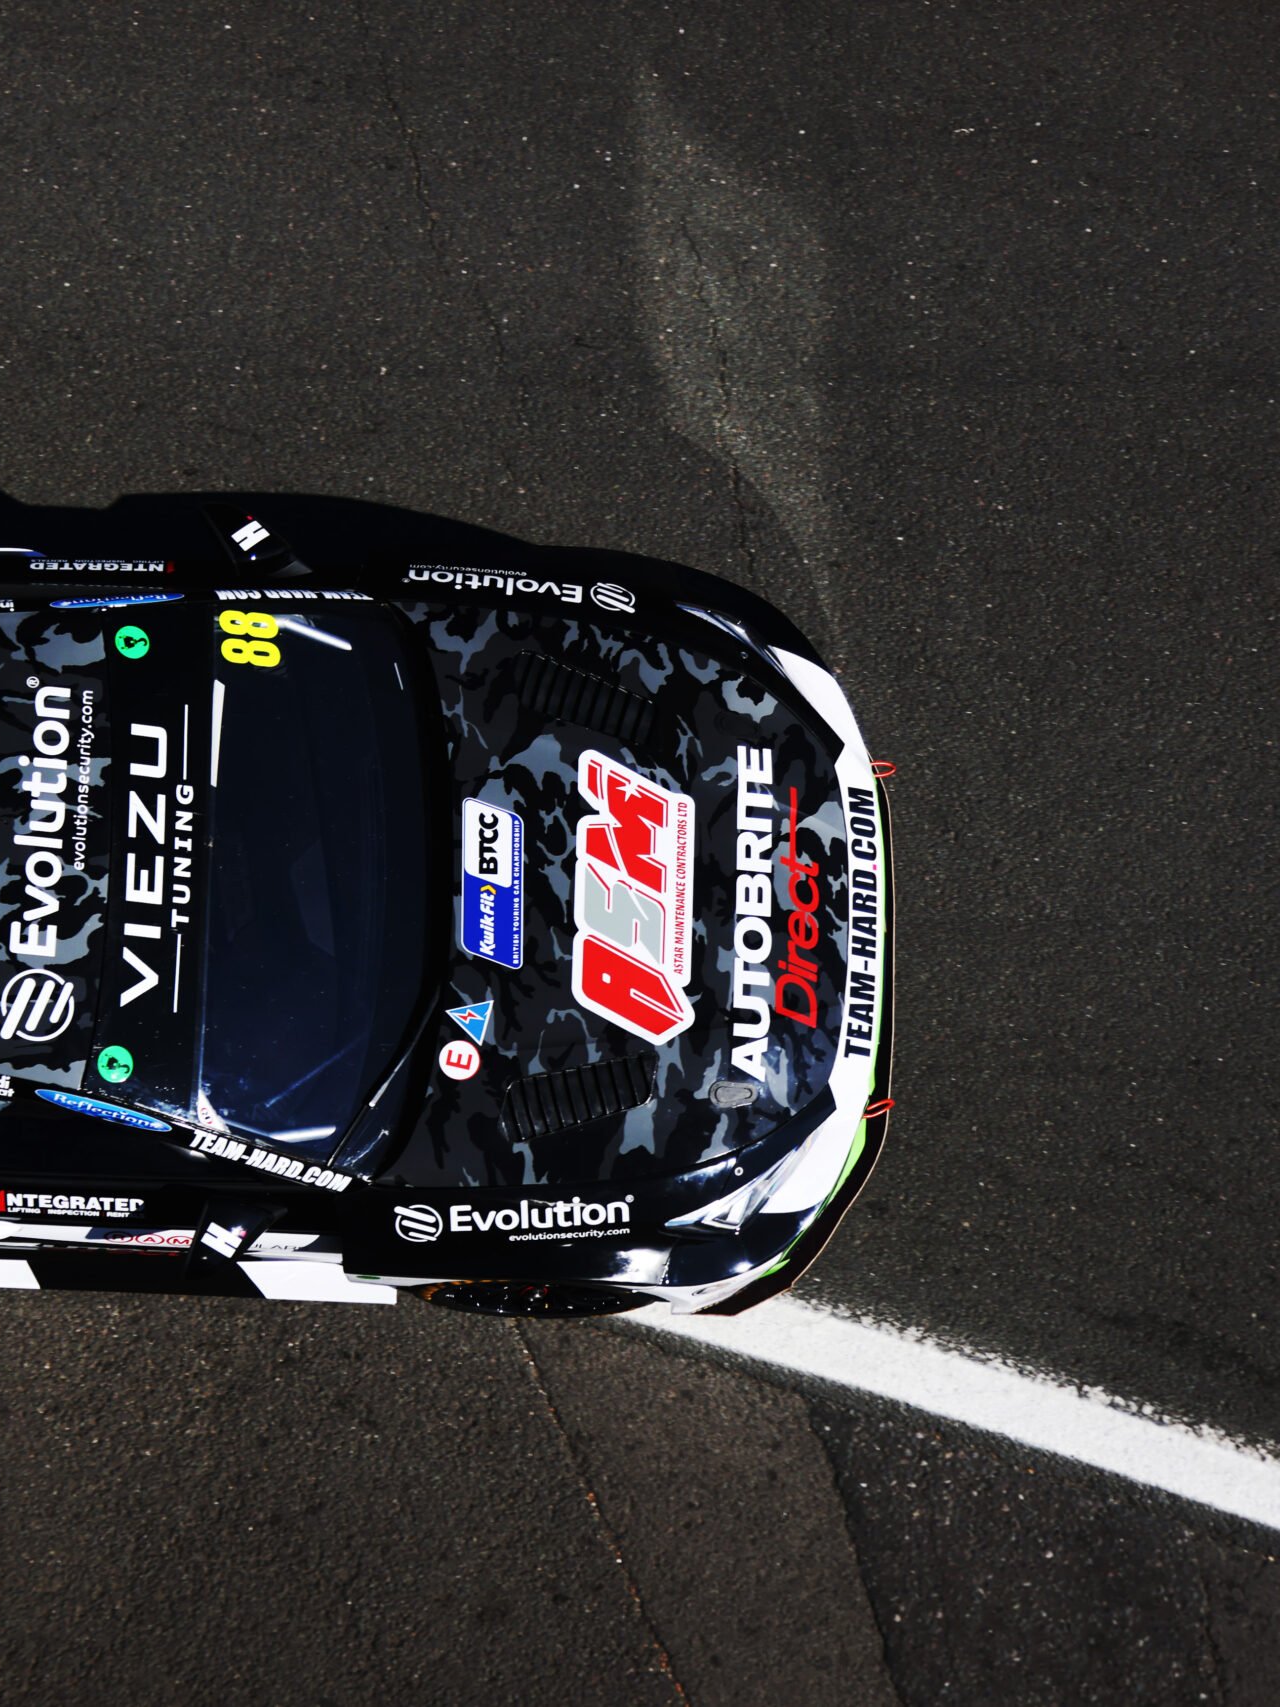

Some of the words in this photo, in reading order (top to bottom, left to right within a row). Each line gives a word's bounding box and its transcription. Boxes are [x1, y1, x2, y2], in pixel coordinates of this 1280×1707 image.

[219, 609, 281, 668] 88
[74, 690, 94, 871] evolutionsecurity.com
[676, 802, 688, 818] LTD
[119, 723, 167, 1007] VIEZU
[171, 784, 194, 927] TUNING
[478, 812, 499, 875] BTCC
[513, 819, 521, 877] CHAMPIONSHIP
[675, 819, 687, 880] CONTRACTORS
[512, 898, 520, 932] TOURING
[580, 760, 685, 1036] ASM
[674, 881, 685, 945] MAINTENANCE
[731, 745, 773, 1082] AUTOBRITE
[775, 787, 820, 1029] Direct
[843, 787, 878, 1058] TEAM-HARD.COM
[512, 934, 520, 965] BRITISH
[673, 946, 684, 976] ASTAR
[446, 1049, 473, 1070] E
[188, 1129, 353, 1192] TEAM-HARD.COM
[7, 1206, 42, 1215] LIFTING
[47, 1208, 100, 1217] INSPECTION
[509, 1227, 630, 1242] evolutionsecurity.com
